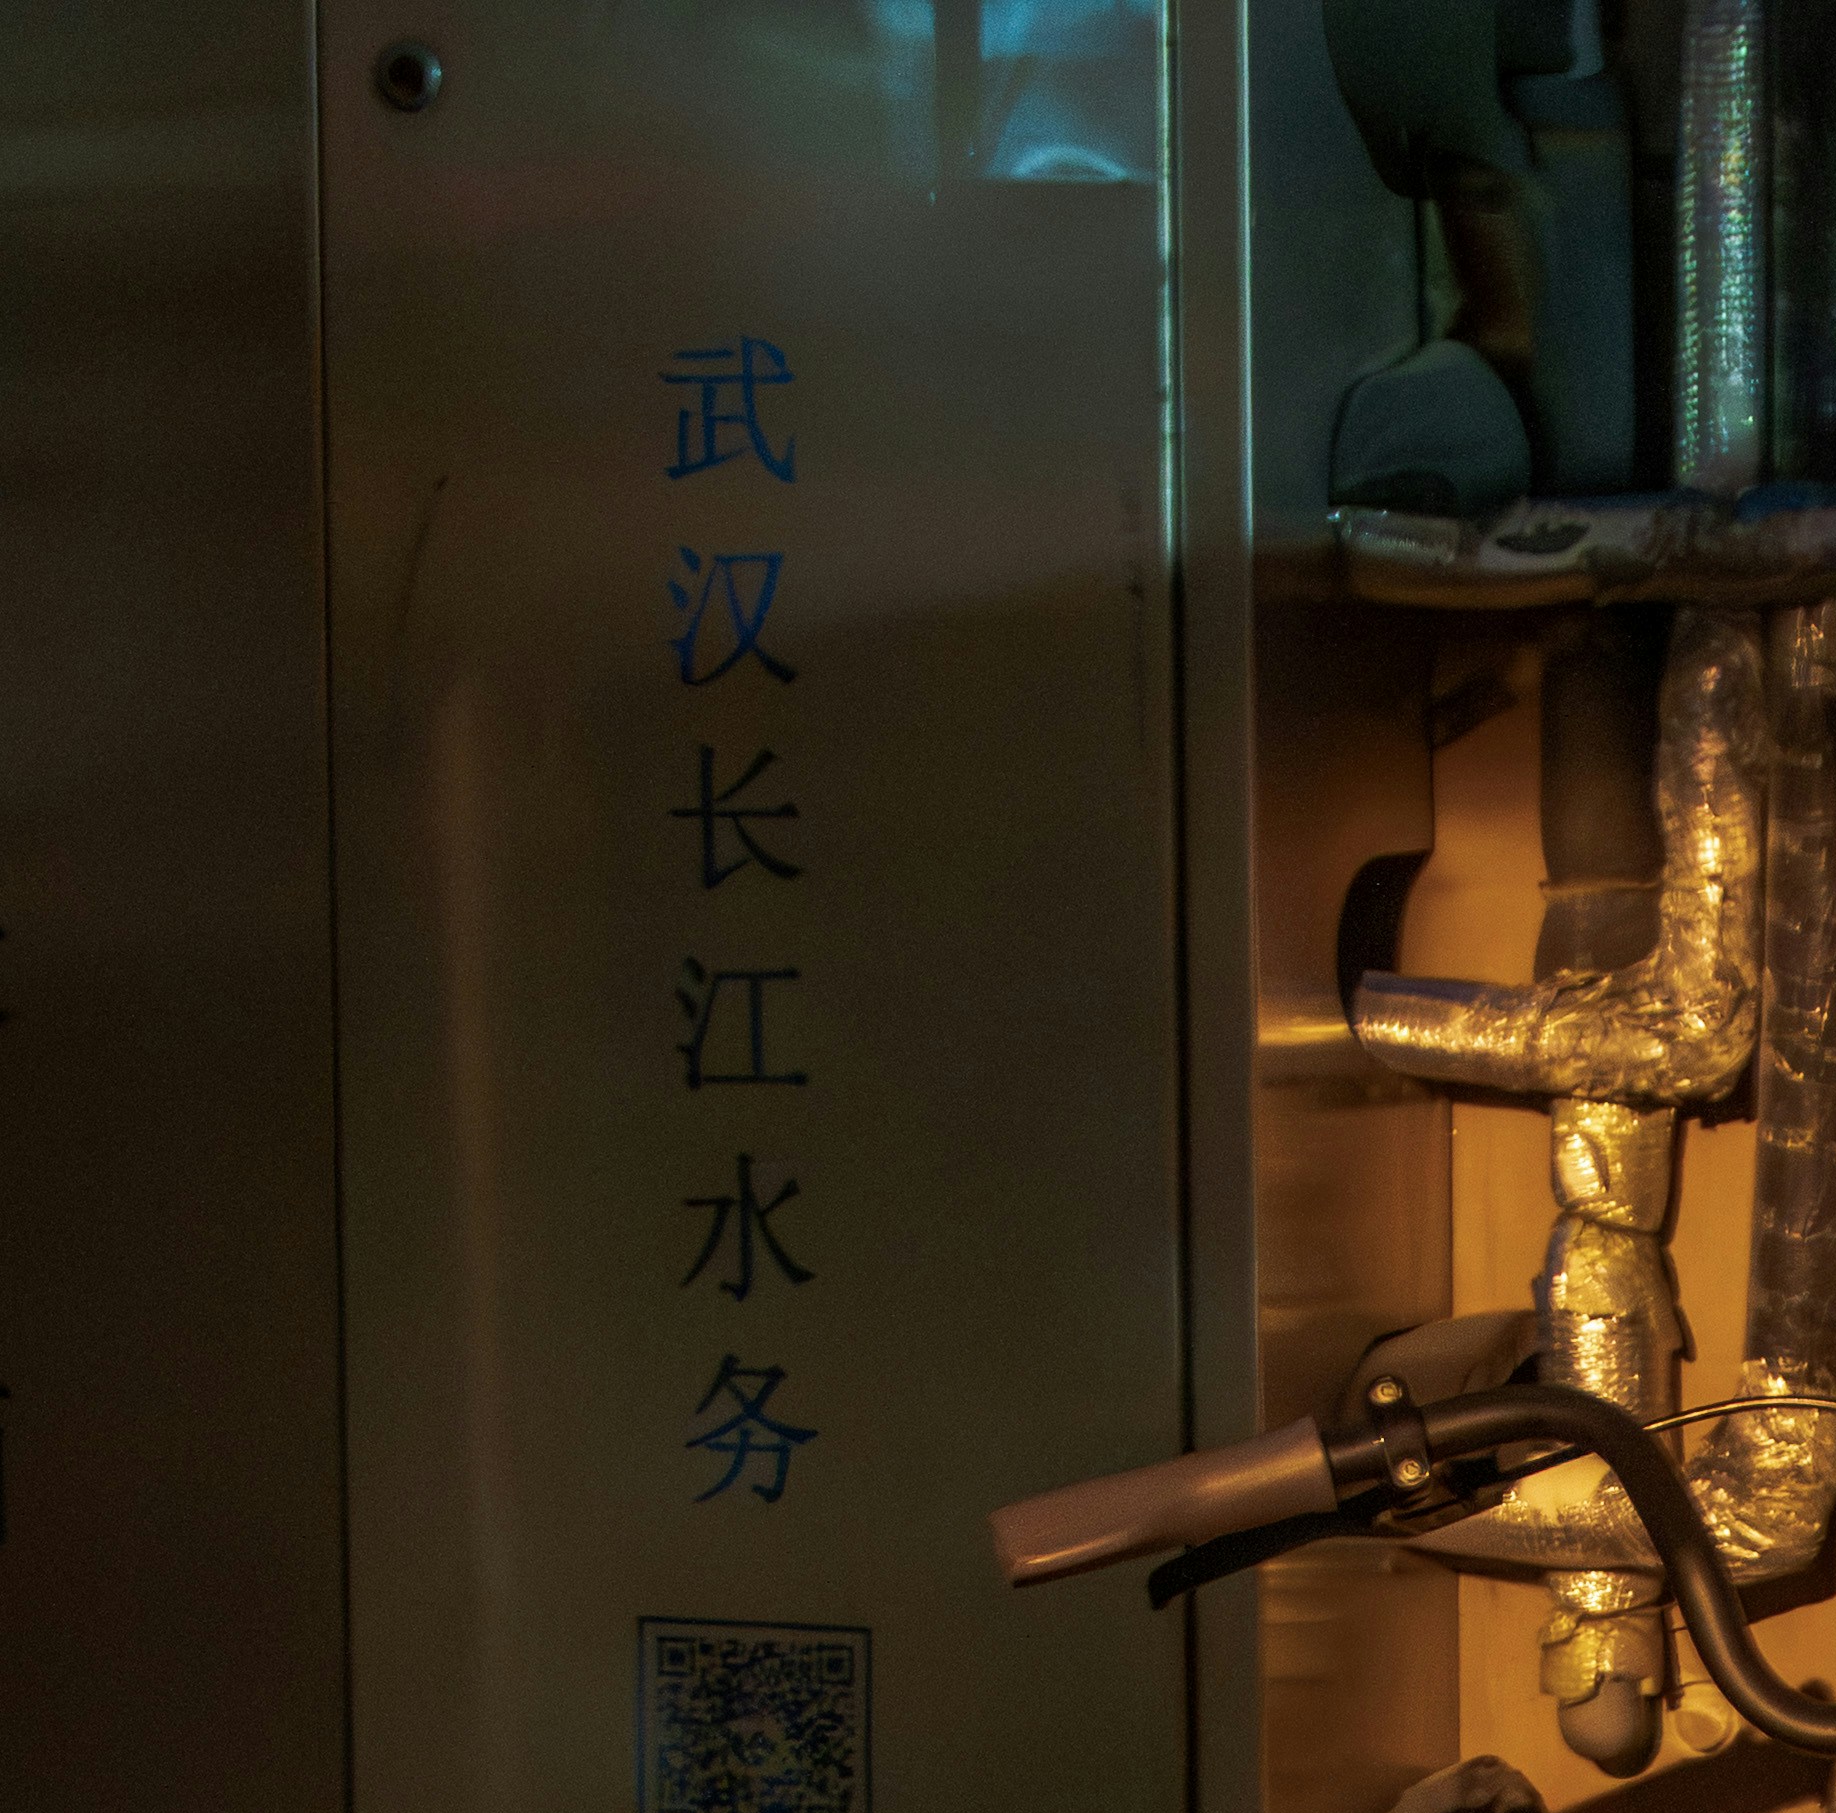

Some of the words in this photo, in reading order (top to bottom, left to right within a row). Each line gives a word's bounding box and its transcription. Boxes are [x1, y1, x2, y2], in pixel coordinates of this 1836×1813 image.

[658, 335, 819, 1505] 武汉长江水务
